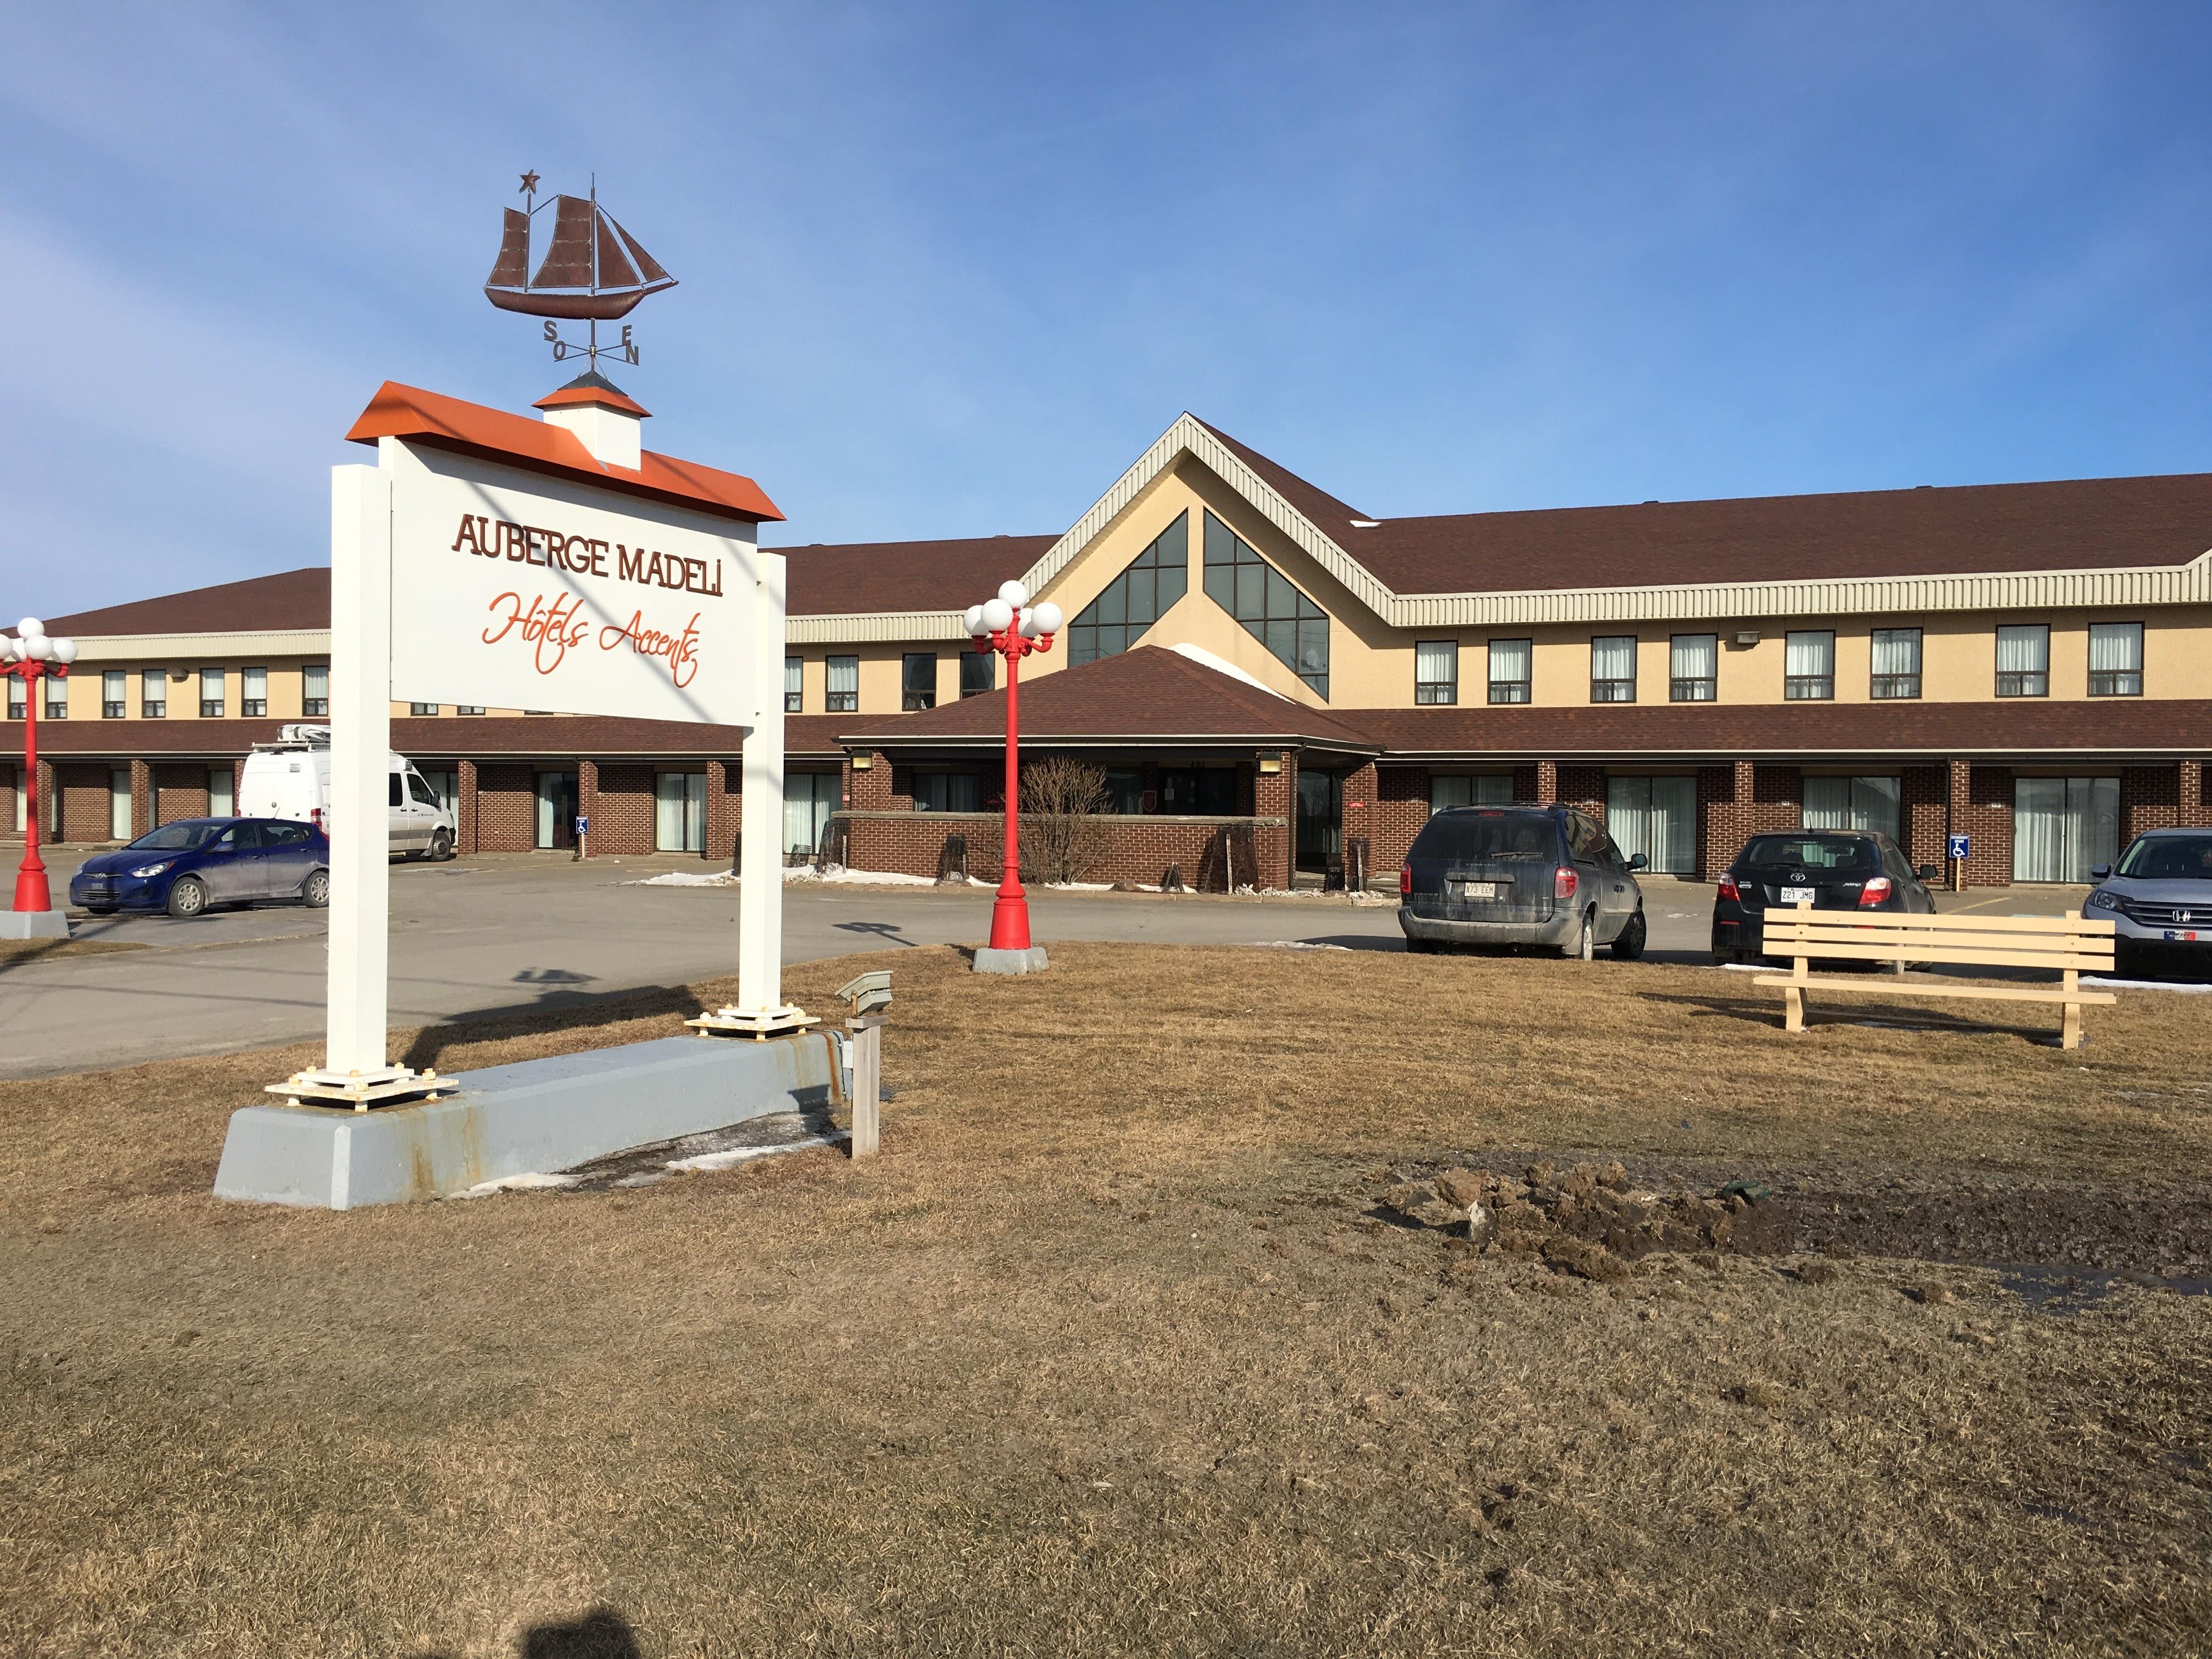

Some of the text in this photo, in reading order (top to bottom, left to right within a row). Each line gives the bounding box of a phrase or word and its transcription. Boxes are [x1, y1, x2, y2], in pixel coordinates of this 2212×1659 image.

[544, 320, 558, 341] S
[622, 325, 632, 346] E
[553, 340, 566, 360] O
[626, 345, 639, 365] N
[452, 514, 609, 577] AUBERGE
[482, 592, 700, 688] Hôtels Accents
[1782, 890, 1813, 900] Z21 JMG
